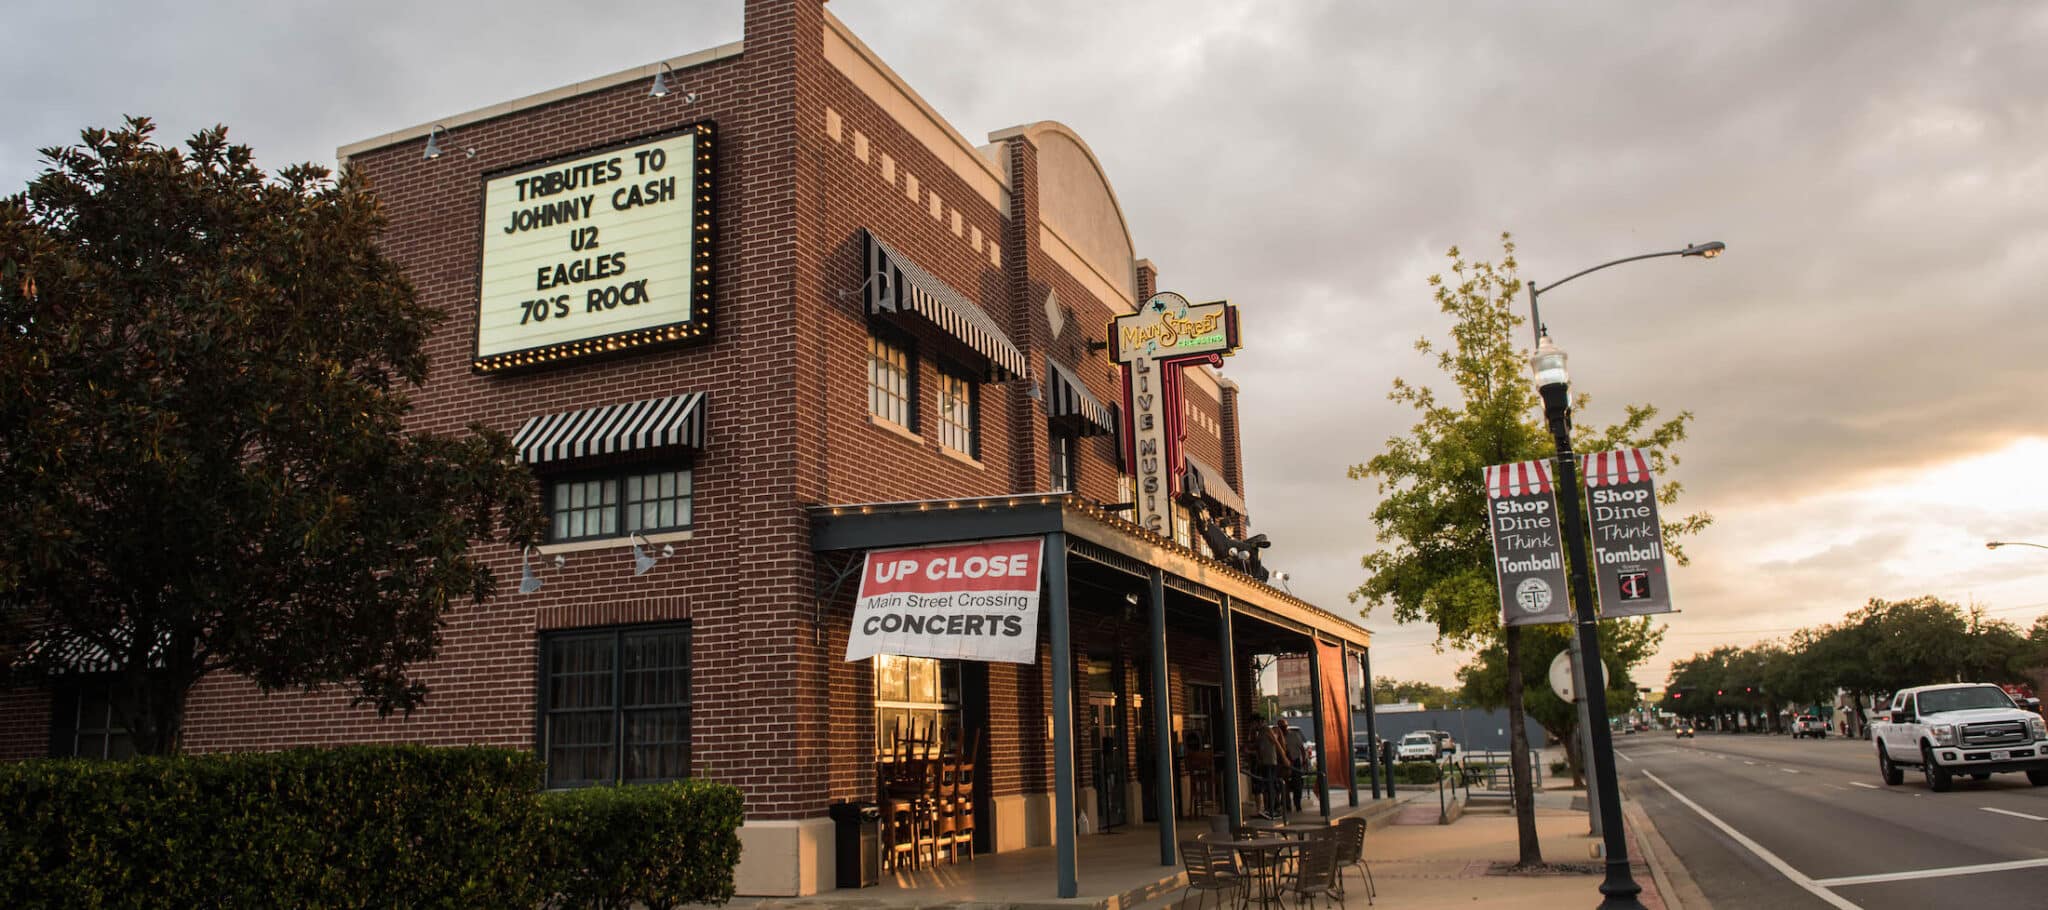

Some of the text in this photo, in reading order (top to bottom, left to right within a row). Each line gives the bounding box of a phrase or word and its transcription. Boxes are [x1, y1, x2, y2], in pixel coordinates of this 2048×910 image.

[515, 148, 666, 202] TRIBUTES TO
[504, 176, 675, 234] JOHNNY CASH
[570, 226, 599, 252] U2
[536, 252, 626, 291] EAGLES
[520, 279, 650, 325] 70'S ROCK
[1136, 357, 1153, 431] LIVE
[1140, 438, 1162, 533] MUSIC
[1593, 489, 1649, 504] Shop
[1496, 500, 1549, 515] Shop
[1596, 505, 1650, 522] Dine
[1498, 516, 1551, 532] Dine
[1598, 522, 1654, 542] Think
[1501, 532, 1554, 551] Think
[1499, 552, 1560, 574] Tomball
[1596, 542, 1660, 565] Tomball
[875, 553, 1029, 584] UP CLOSE
[866, 592, 1028, 610] Main Street Crossing
[862, 613, 1022, 637] CONCERTS
